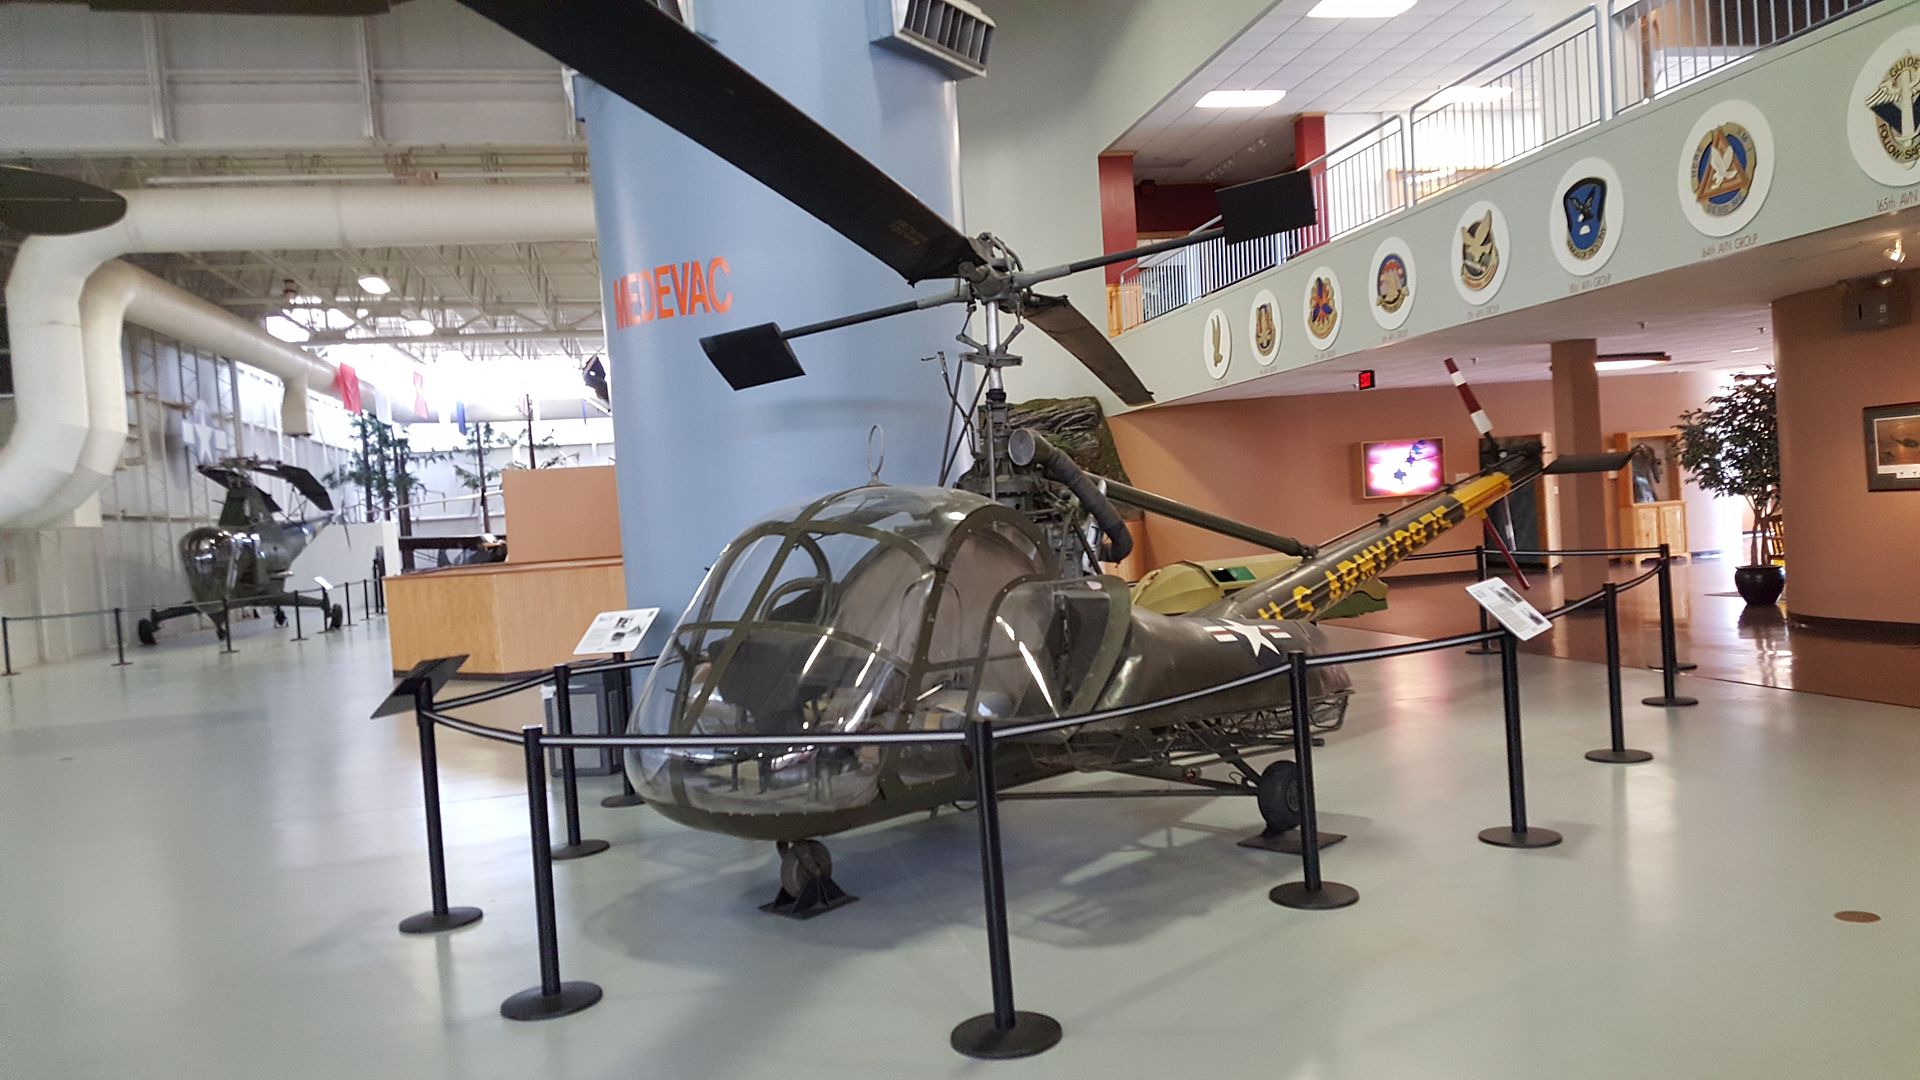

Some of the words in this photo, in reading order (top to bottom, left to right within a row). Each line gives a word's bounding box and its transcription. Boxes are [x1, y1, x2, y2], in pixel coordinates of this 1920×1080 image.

[1879, 123, 1902, 159] FOLLOW
[613, 256, 734, 330] MEDEVAC
[1324, 541, 1387, 600] ARMY
